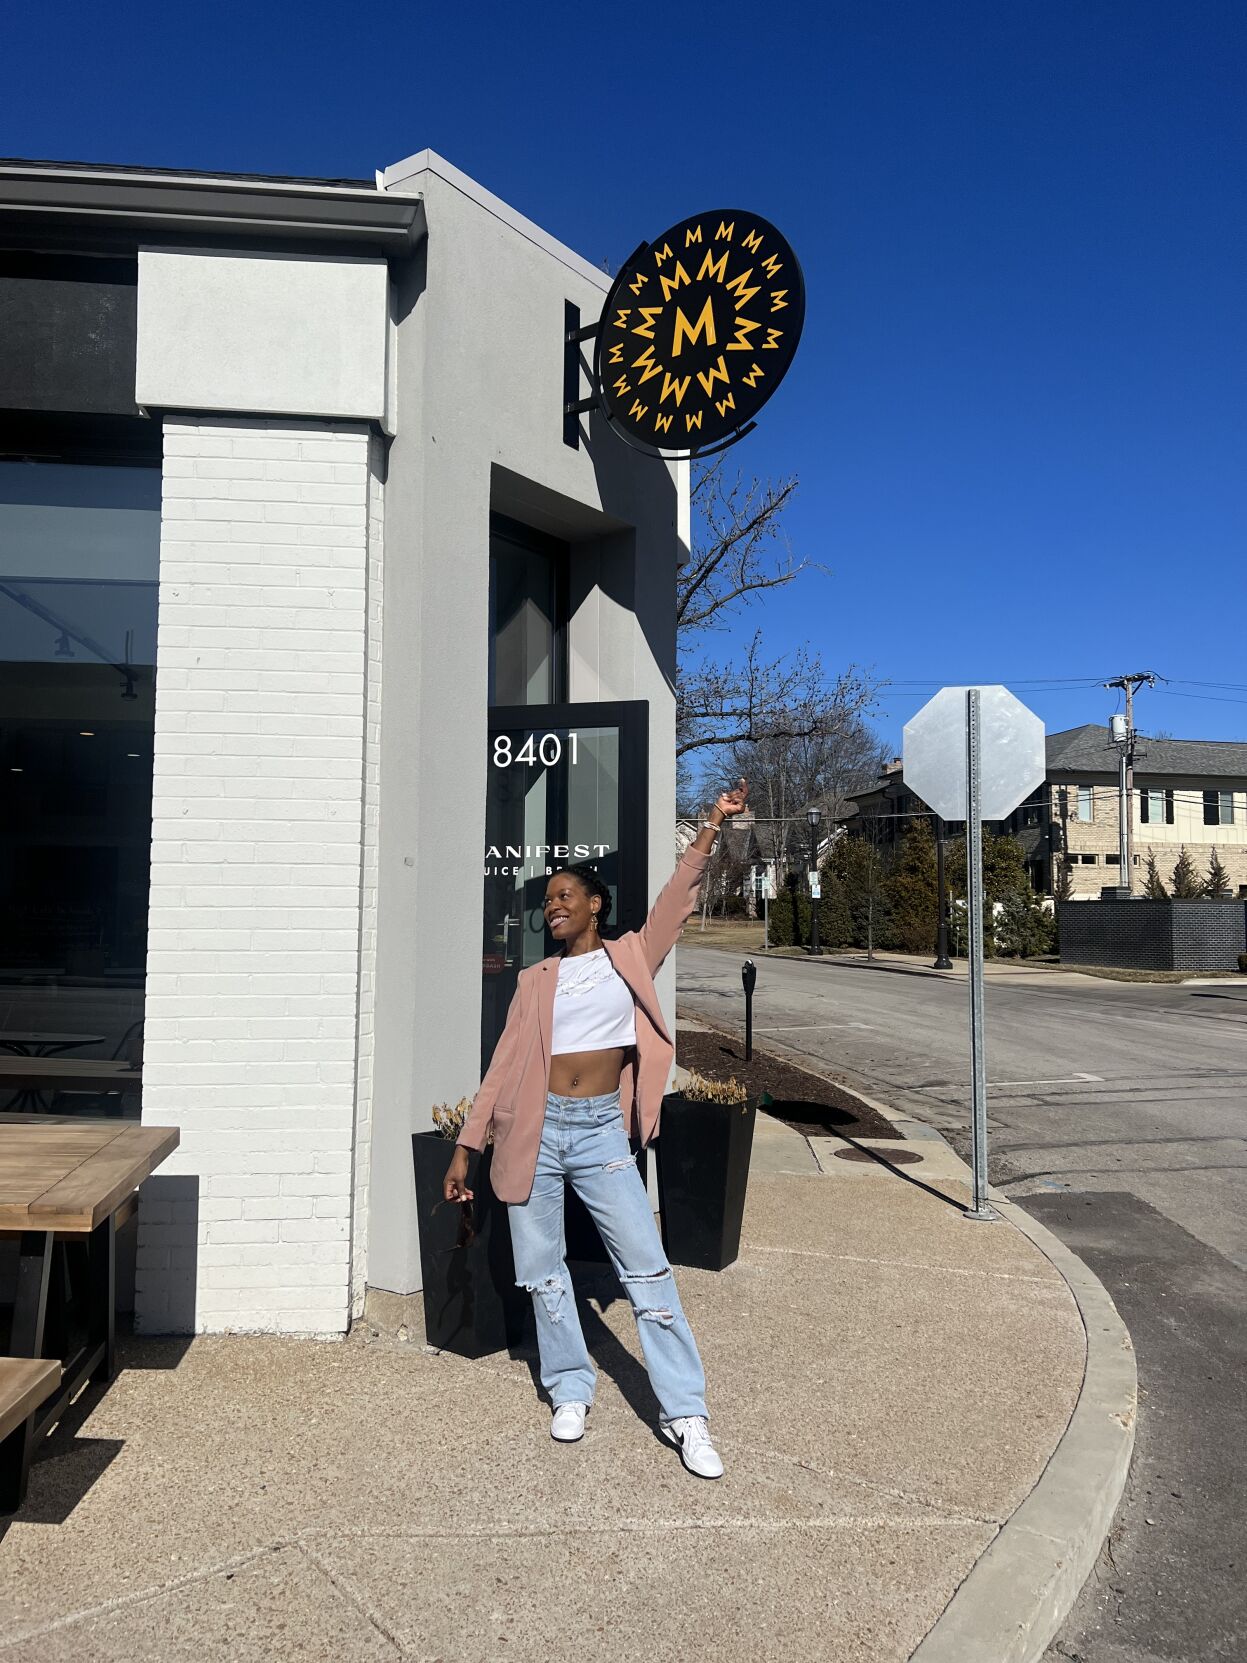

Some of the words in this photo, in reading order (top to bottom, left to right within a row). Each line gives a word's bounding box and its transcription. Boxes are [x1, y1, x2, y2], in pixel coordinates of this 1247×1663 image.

[685, 225, 703, 248] M
[714, 222, 735, 242] M
[741, 230, 763, 255] M
[654, 243, 673, 268] M
[696, 249, 730, 284] M
[761, 254, 782, 280] M
[628, 273, 649, 296] M
[659, 260, 692, 302] M
[725, 268, 761, 311] M
[770, 289, 789, 313] M
[612, 309, 632, 329] M
[631, 306, 664, 340] M
[671, 295, 717, 358] M
[493, 732, 578, 768] 8401
[486, 844, 611, 858] ANIFEST
[484, 866, 519, 877] UICE
